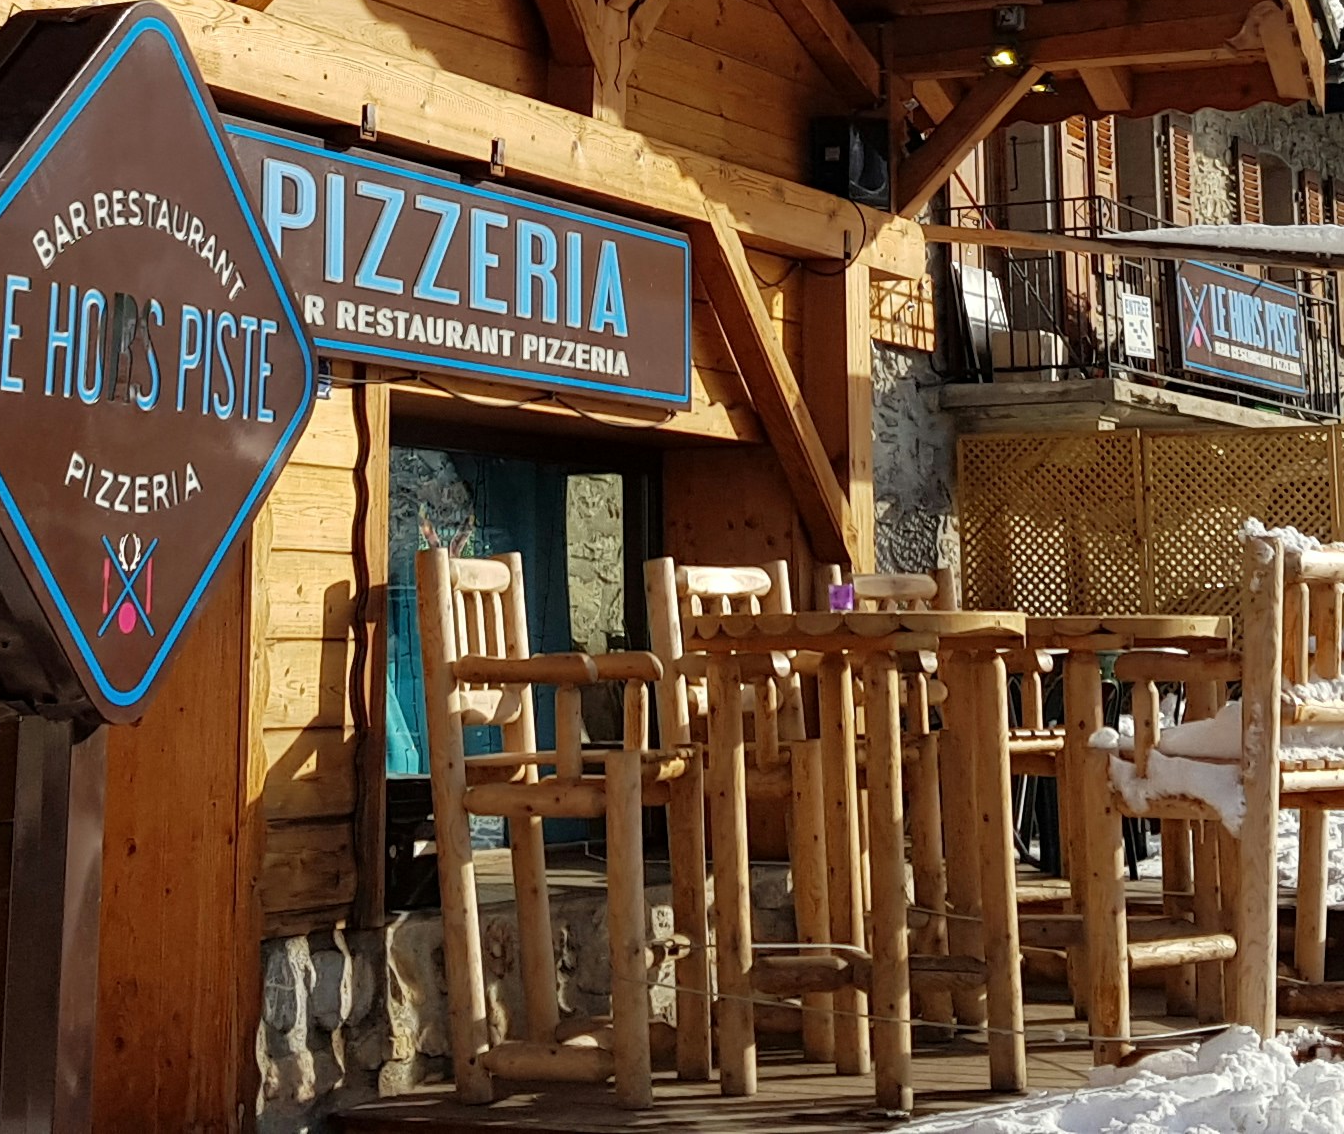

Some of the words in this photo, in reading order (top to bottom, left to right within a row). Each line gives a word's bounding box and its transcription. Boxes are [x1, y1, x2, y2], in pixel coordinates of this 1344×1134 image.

[32, 201, 92, 269] BAR
[93, 189, 246, 301] RESTAURANT
[261, 157, 628, 338] PIZZERIA
[45, 282, 165, 412] HORS
[176, 304, 279, 424] PISTE
[336, 300, 516, 357] RESTAURANT
[522, 333, 630, 378] PIZZERIA
[1209, 283, 1230, 340] LE
[1228, 289, 1265, 349] HORS
[1264, 300, 1300, 358] PISTE
[64, 451, 203, 514] PIZZERIA
